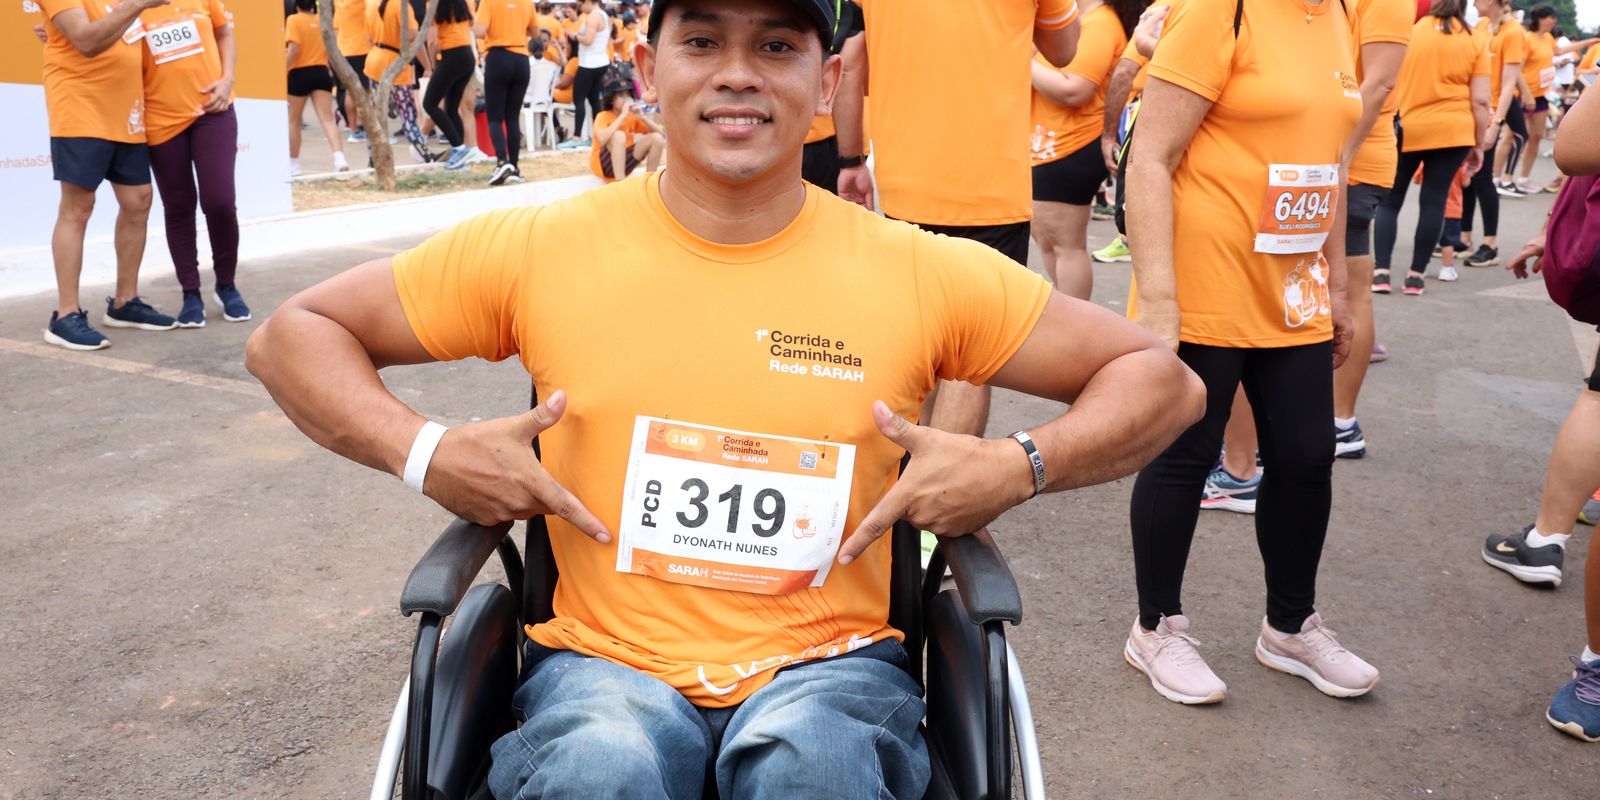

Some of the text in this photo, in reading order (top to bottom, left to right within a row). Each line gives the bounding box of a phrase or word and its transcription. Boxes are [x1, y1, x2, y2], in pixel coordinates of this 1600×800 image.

[152, 26, 192, 47] 3986
[1275, 191, 1331, 221] 6494
[770, 330, 831, 348] Corrida
[835, 340, 844, 350] e
[770, 344, 862, 367] Caminhada
[769, 359, 864, 382] Rede SARAH
[672, 434, 698, 447] 3 KM
[723, 443, 769, 457] Caminhada
[724, 436, 754, 447] Corrida
[722, 452, 769, 465] Rede SARAH
[641, 479, 662, 528] PCD
[675, 478, 786, 538] 319
[673, 534, 778, 556] DYONATH NUNES
[668, 563, 709, 578] SARAH
